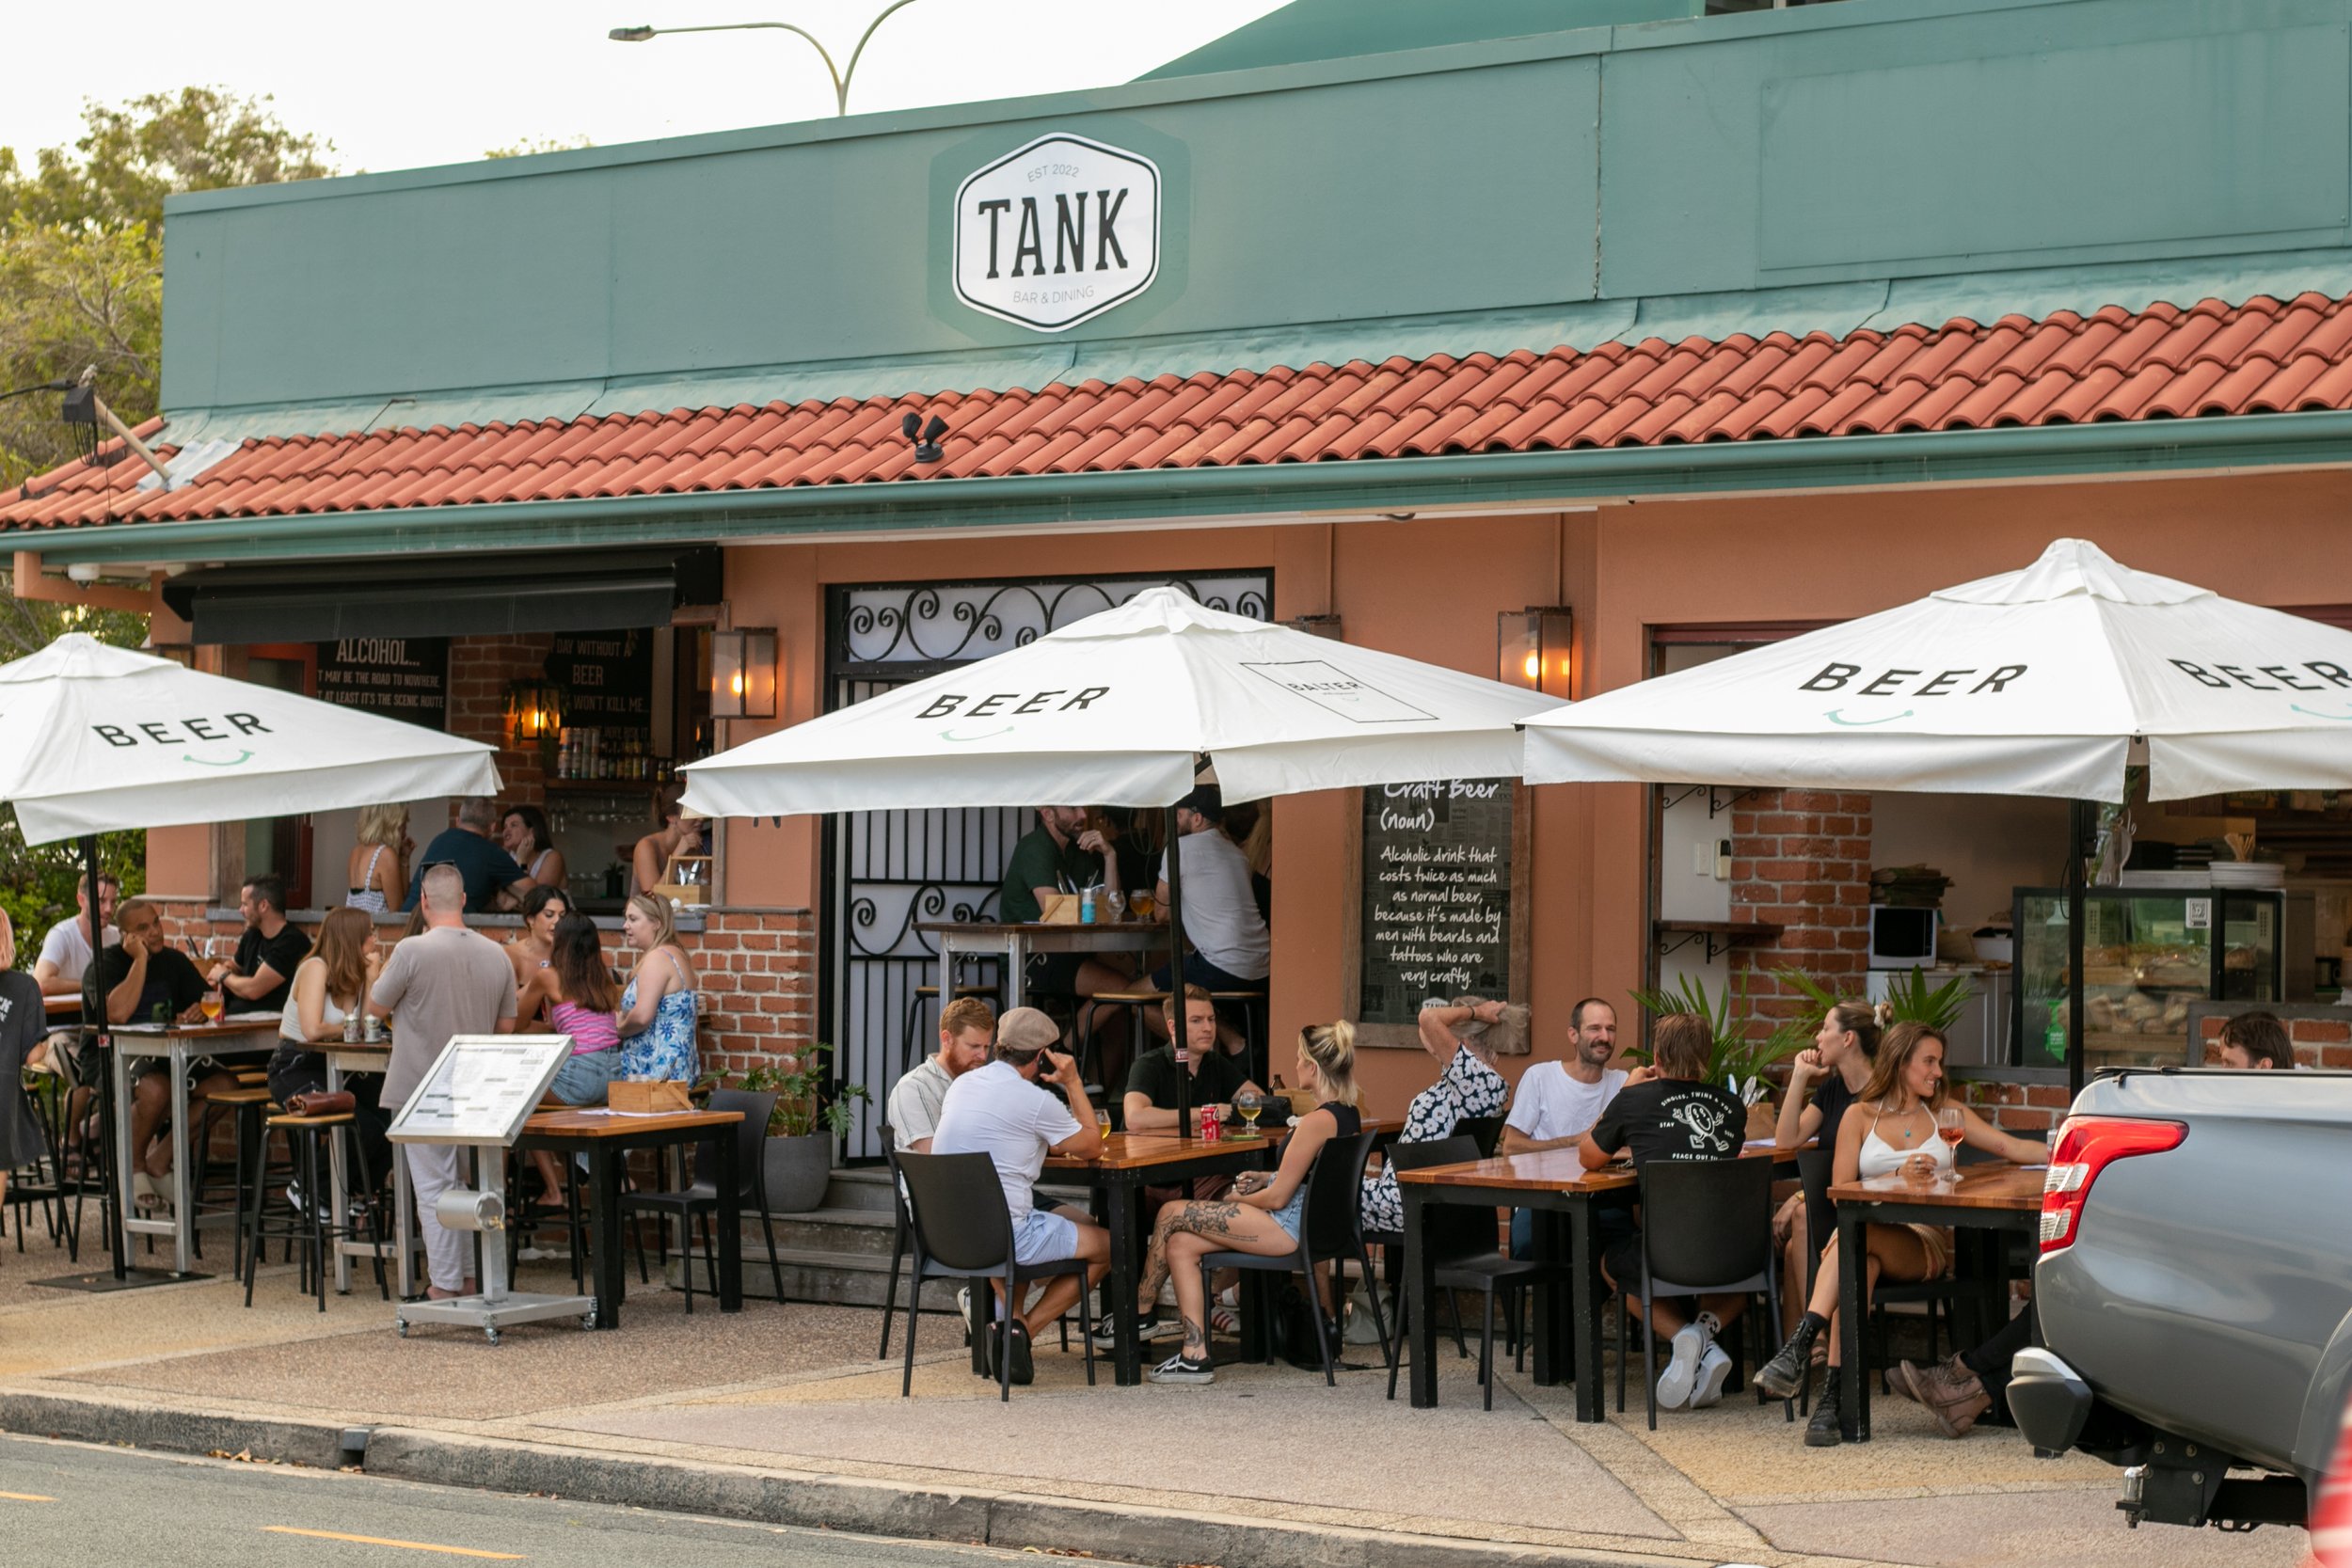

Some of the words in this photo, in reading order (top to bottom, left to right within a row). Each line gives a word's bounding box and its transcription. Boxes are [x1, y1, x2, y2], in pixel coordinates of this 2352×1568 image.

[1027, 166, 1048, 182] EST
[1052, 164, 1080, 178] 2022
[978, 188, 1129, 279] TANK
[1012, 291, 1038, 304] BAR
[1041, 293, 1049, 304] &
[1052, 285, 1094, 304] DINING
[336, 639, 421, 666] ALCOHOL...
[556, 638, 574, 655] DAY
[577, 640, 621, 657] WITHOUT
[325, 671, 342, 683] MAY
[343, 671, 353, 684] BE
[355, 672, 369, 685] THE
[372, 673, 390, 686] ROAD
[392, 673, 403, 686] TO
[572, 664, 604, 686] BEER
[1798, 661, 2027, 696] BEER
[2167, 658, 2352, 691] BEER
[1287, 682, 1363, 691] BALTER
[325, 690, 335, 703] AT
[337, 691, 359, 705] LEAST
[360, 692, 375, 705] IT'S
[377, 692, 391, 706] THE
[394, 693, 419, 707] SCENIC
[421, 695, 444, 708] ROUTE
[573, 694, 603, 710] WON'T
[606, 695, 626, 712] KILL
[914, 687, 1110, 719] BEER
[90, 712, 275, 747] BEER
[1384, 780, 1446, 800] Craft
[1448, 778, 1499, 799] Beer
[1380, 806, 1436, 832] (noun)
[1380, 845, 1431, 863] Alcoholic
[1433, 845, 1466, 863] drink
[1469, 846, 1498, 863] that
[1379, 866, 1411, 881] costs
[1414, 865, 1447, 882] twice
[1449, 873, 1465, 881] as
[1468, 868, 1497, 883] much
[1392, 892, 1407, 902] as
[1410, 886, 1448, 903] normal
[1451, 885, 1483, 905] beer,
[1375, 904, 1424, 922] because
[1426, 905, 1446, 923] it's
[1449, 908, 1483, 923] made
[1485, 906, 1502, 929] by
[1375, 930, 1398, 942] men
[1402, 926, 1425, 942] with
[1429, 926, 1473, 943] beards
[1475, 928, 1500, 943] and
[1390, 945, 1433, 962] tattoos
[1437, 948, 1458, 963] who
[1460, 953, 1484, 963] are
[1400, 970, 1427, 990] very
[1430, 967, 1471, 990] crafty.
